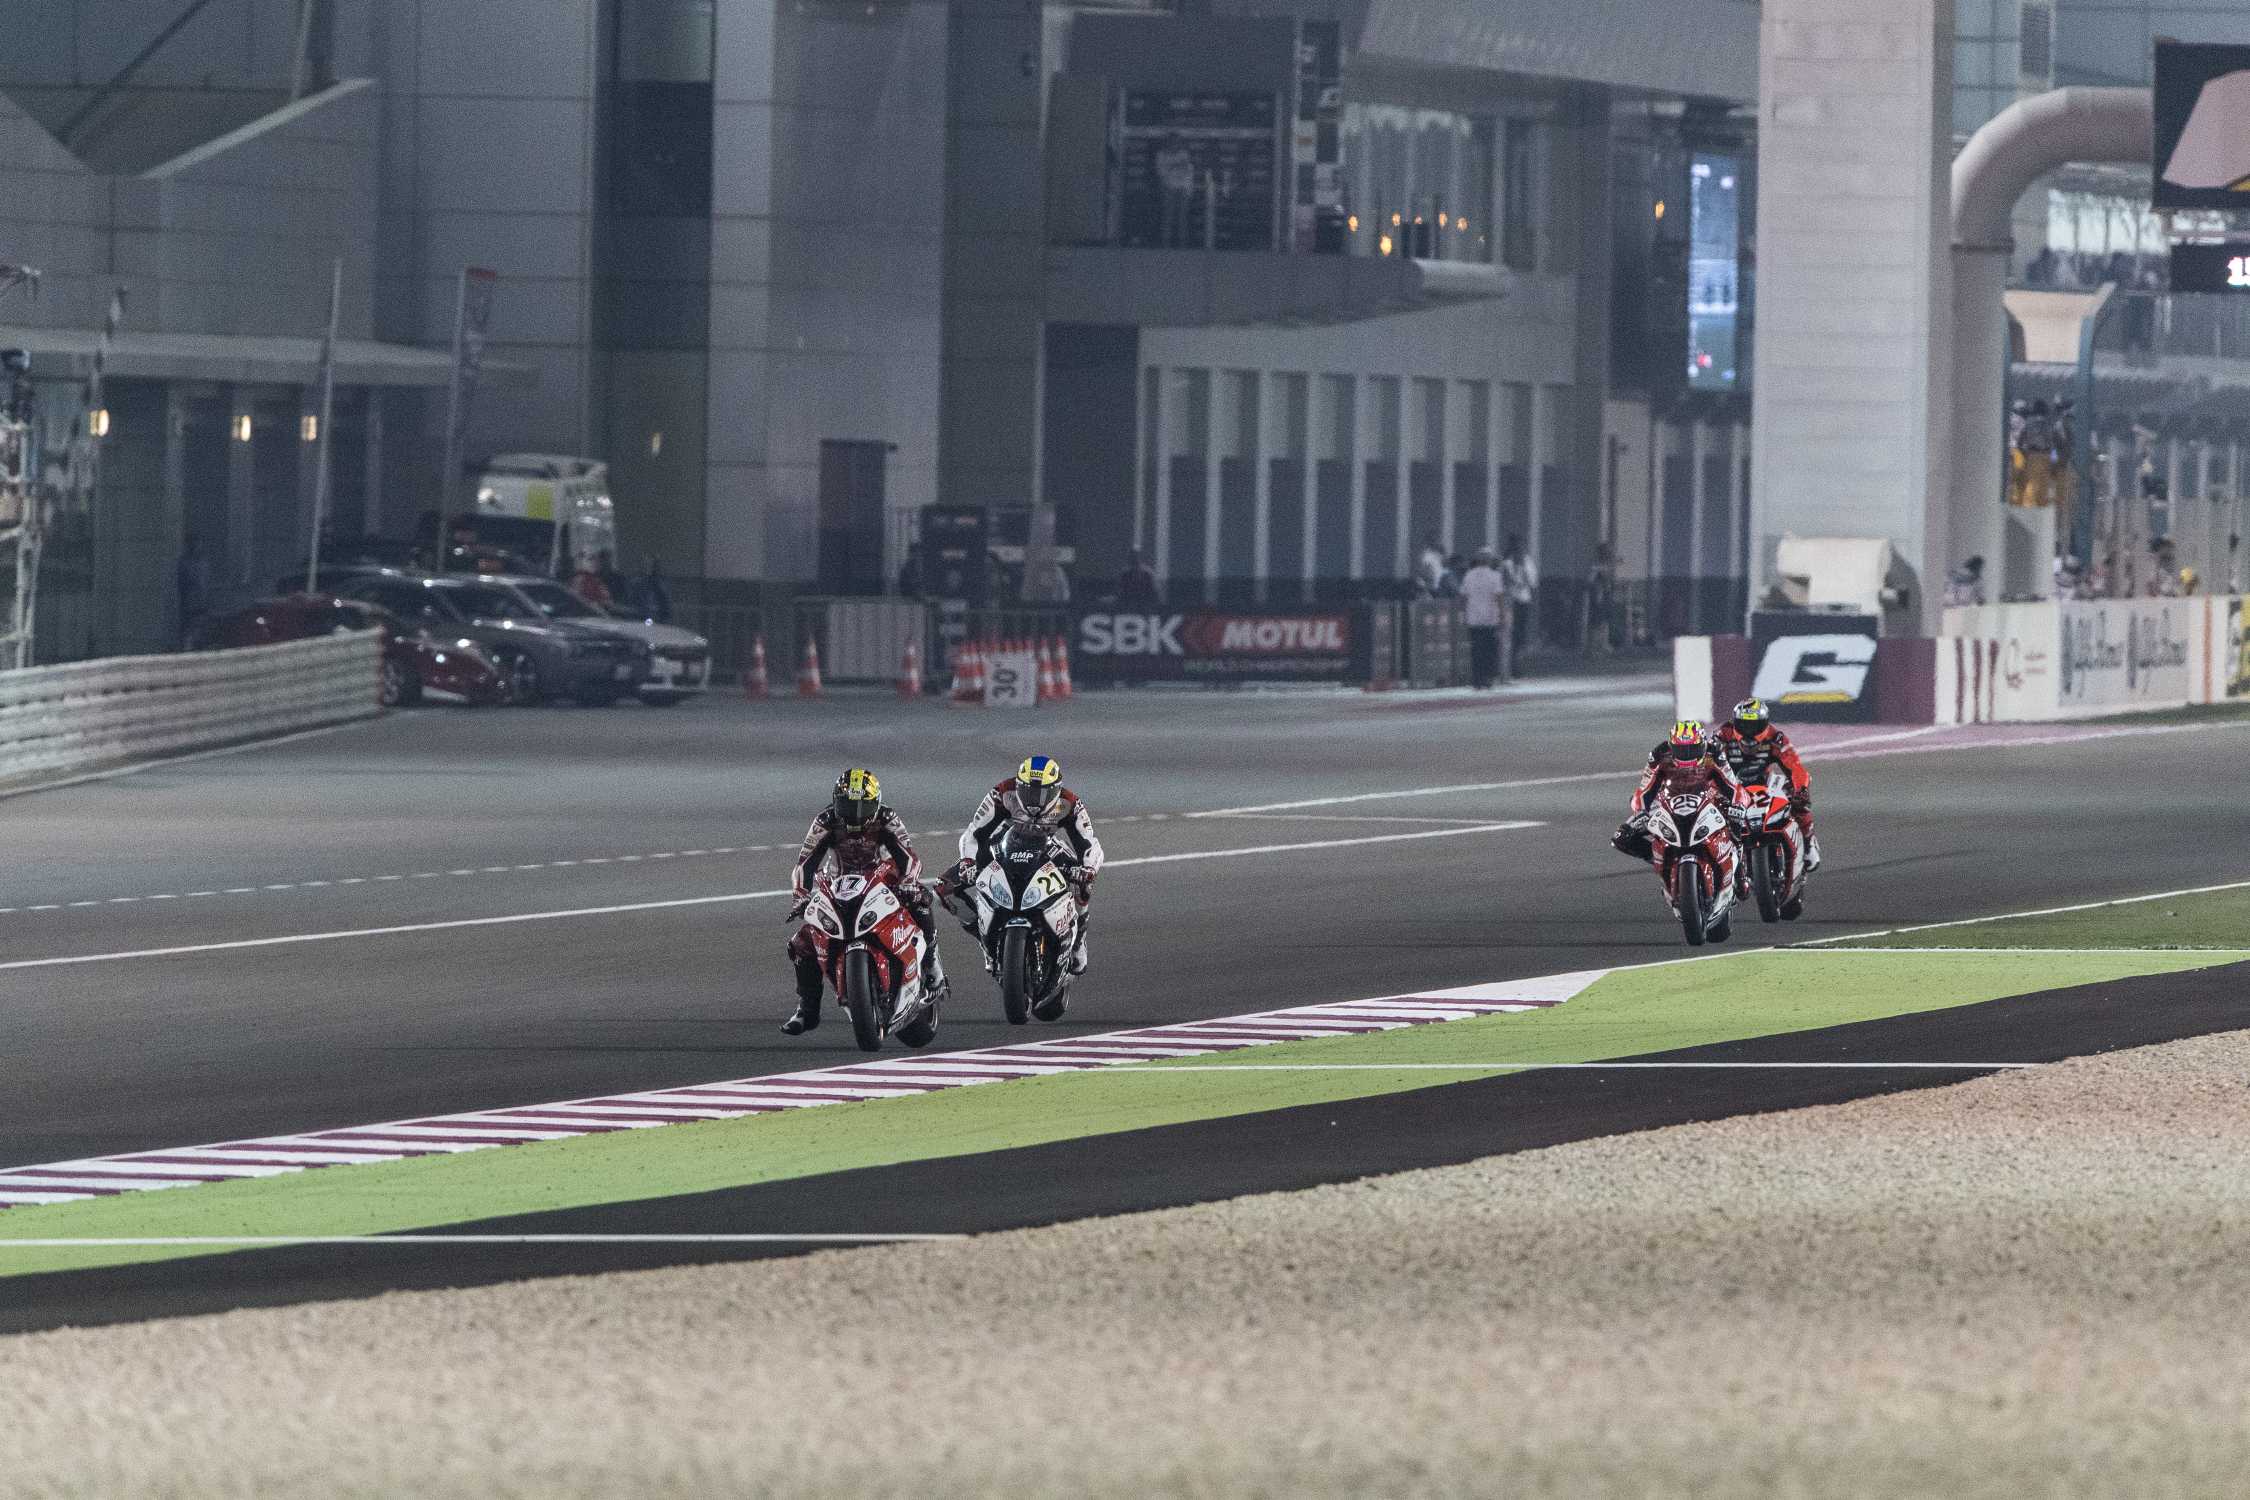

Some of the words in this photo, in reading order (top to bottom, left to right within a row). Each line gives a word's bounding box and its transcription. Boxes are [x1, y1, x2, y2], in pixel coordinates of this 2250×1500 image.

[1080, 614, 1184, 655] SBK
[1222, 619, 1342, 650] MOTUL
[1673, 795, 1698, 809] 25
[1009, 851, 1034, 860] BMP
[835, 876, 863, 893] 17
[1037, 872, 1065, 896] 21
